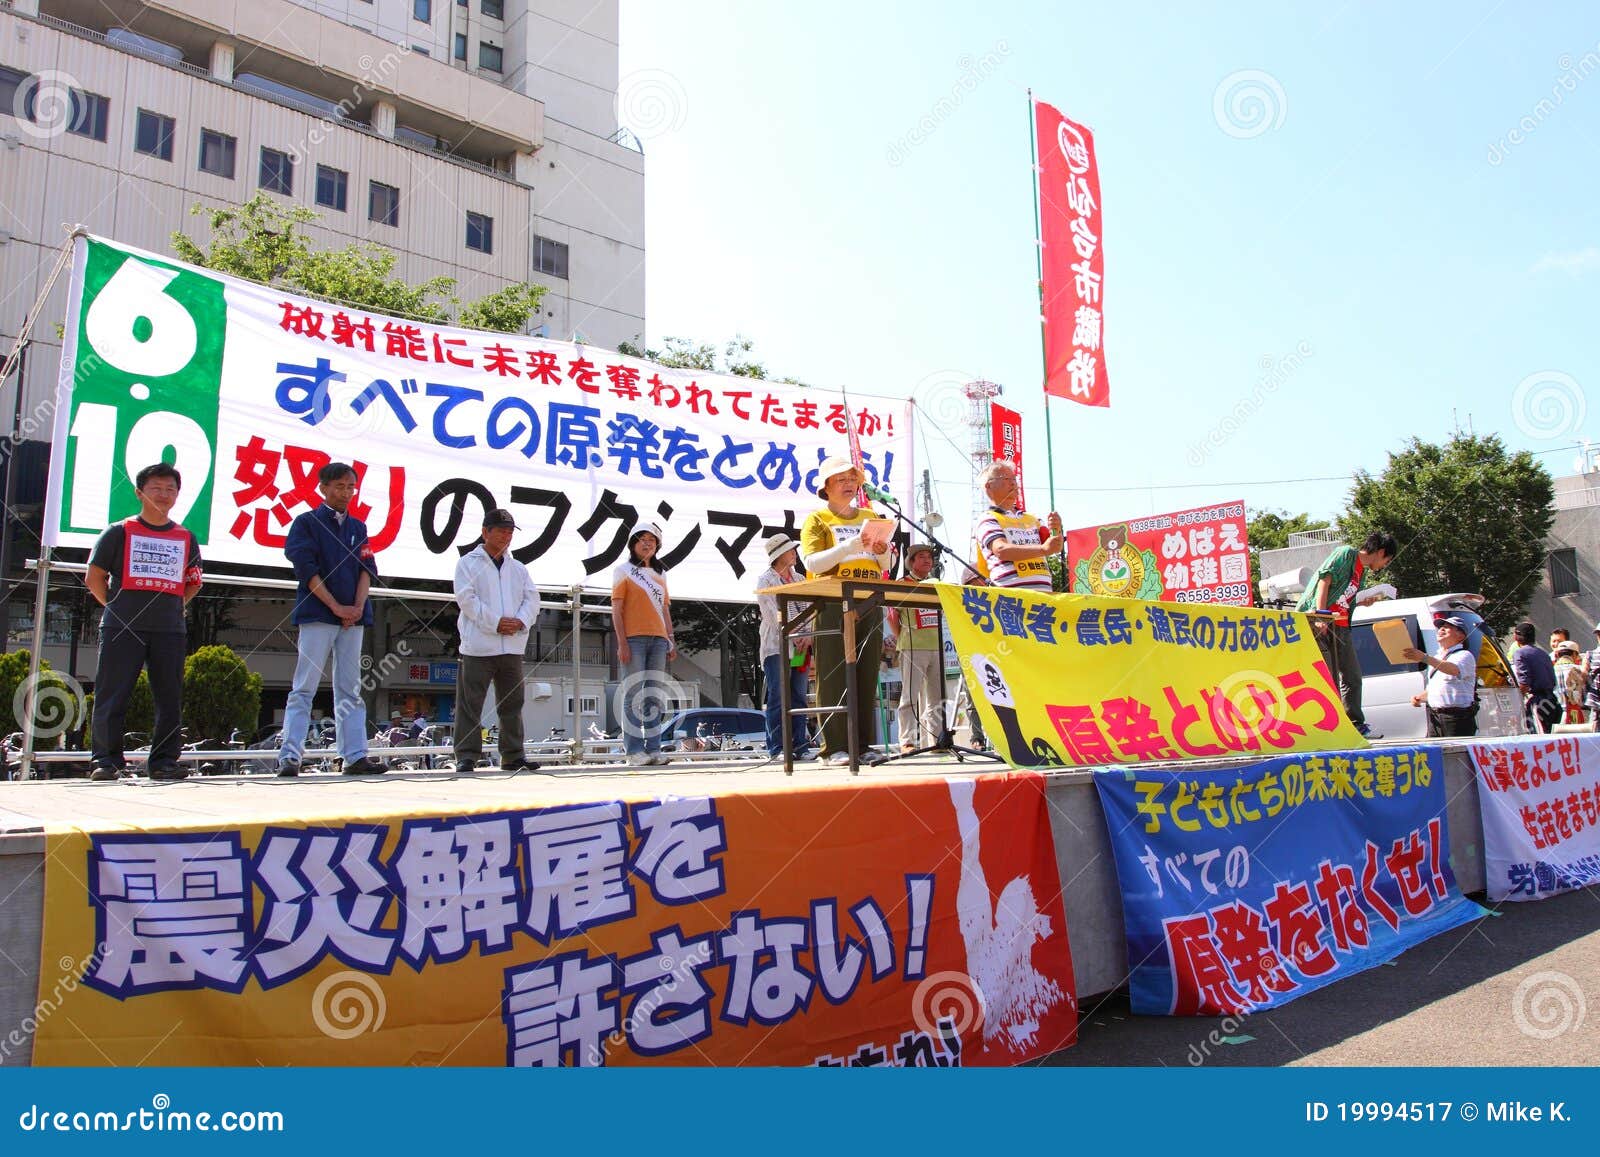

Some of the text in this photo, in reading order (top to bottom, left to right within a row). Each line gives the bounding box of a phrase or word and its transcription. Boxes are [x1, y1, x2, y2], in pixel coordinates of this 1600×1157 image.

[1161, 523, 1245, 559] めばえ
[1163, 553, 1248, 590] 幼稚園
[1134, 751, 1433, 834] 子どもたちの未来を奪うな
[90, 795, 728, 1000] 震災解雇を
[1138, 843, 1250, 899] すべての
[1162, 816, 1450, 1016] 原発をなくせ!
[503, 873, 936, 1067] 許さない!
